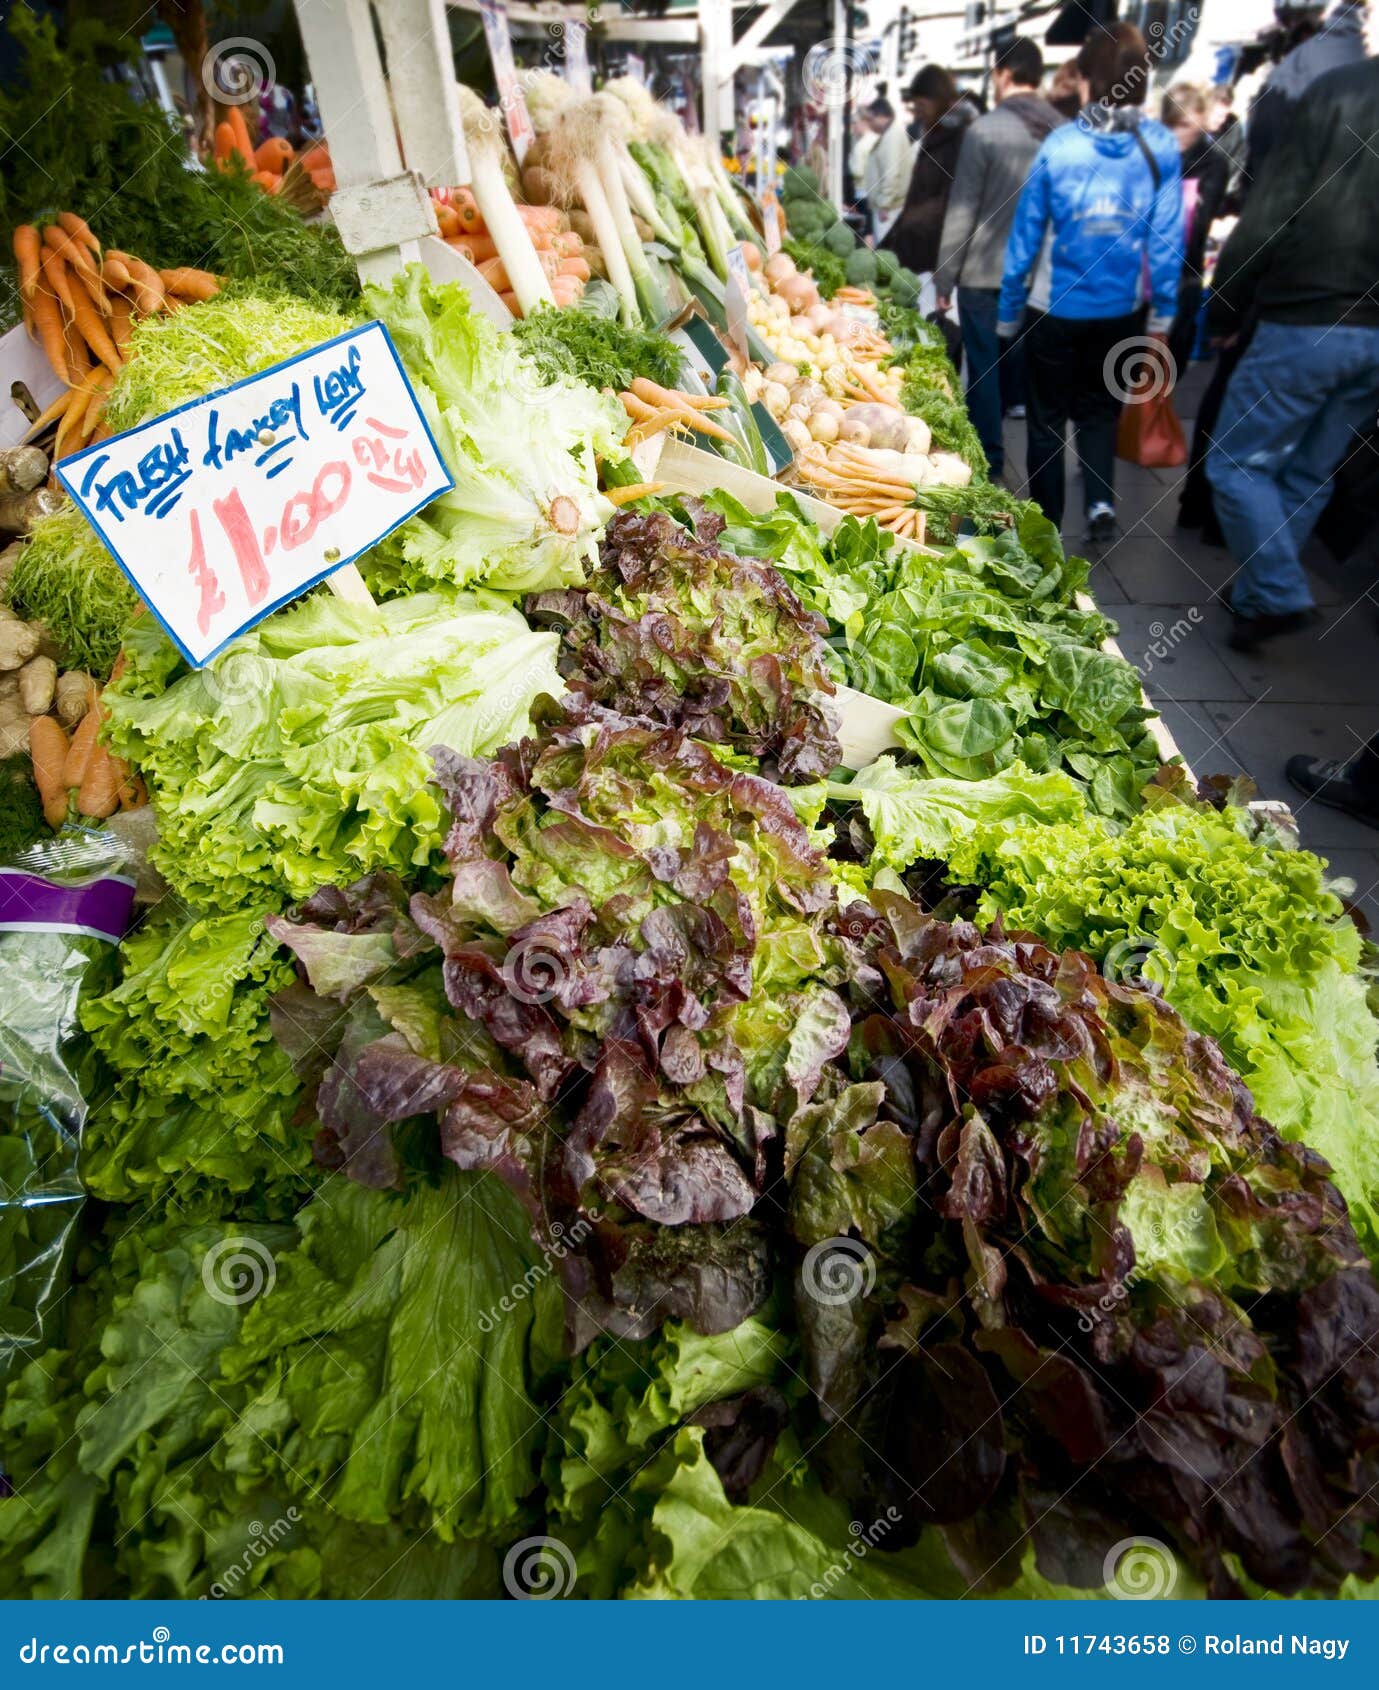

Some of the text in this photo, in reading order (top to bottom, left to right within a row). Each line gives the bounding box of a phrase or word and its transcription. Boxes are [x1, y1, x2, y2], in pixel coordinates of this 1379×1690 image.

[80, 428, 189, 522] FRESH
[314, 345, 366, 416] LEAF
[188, 461, 352, 637] £1.00
